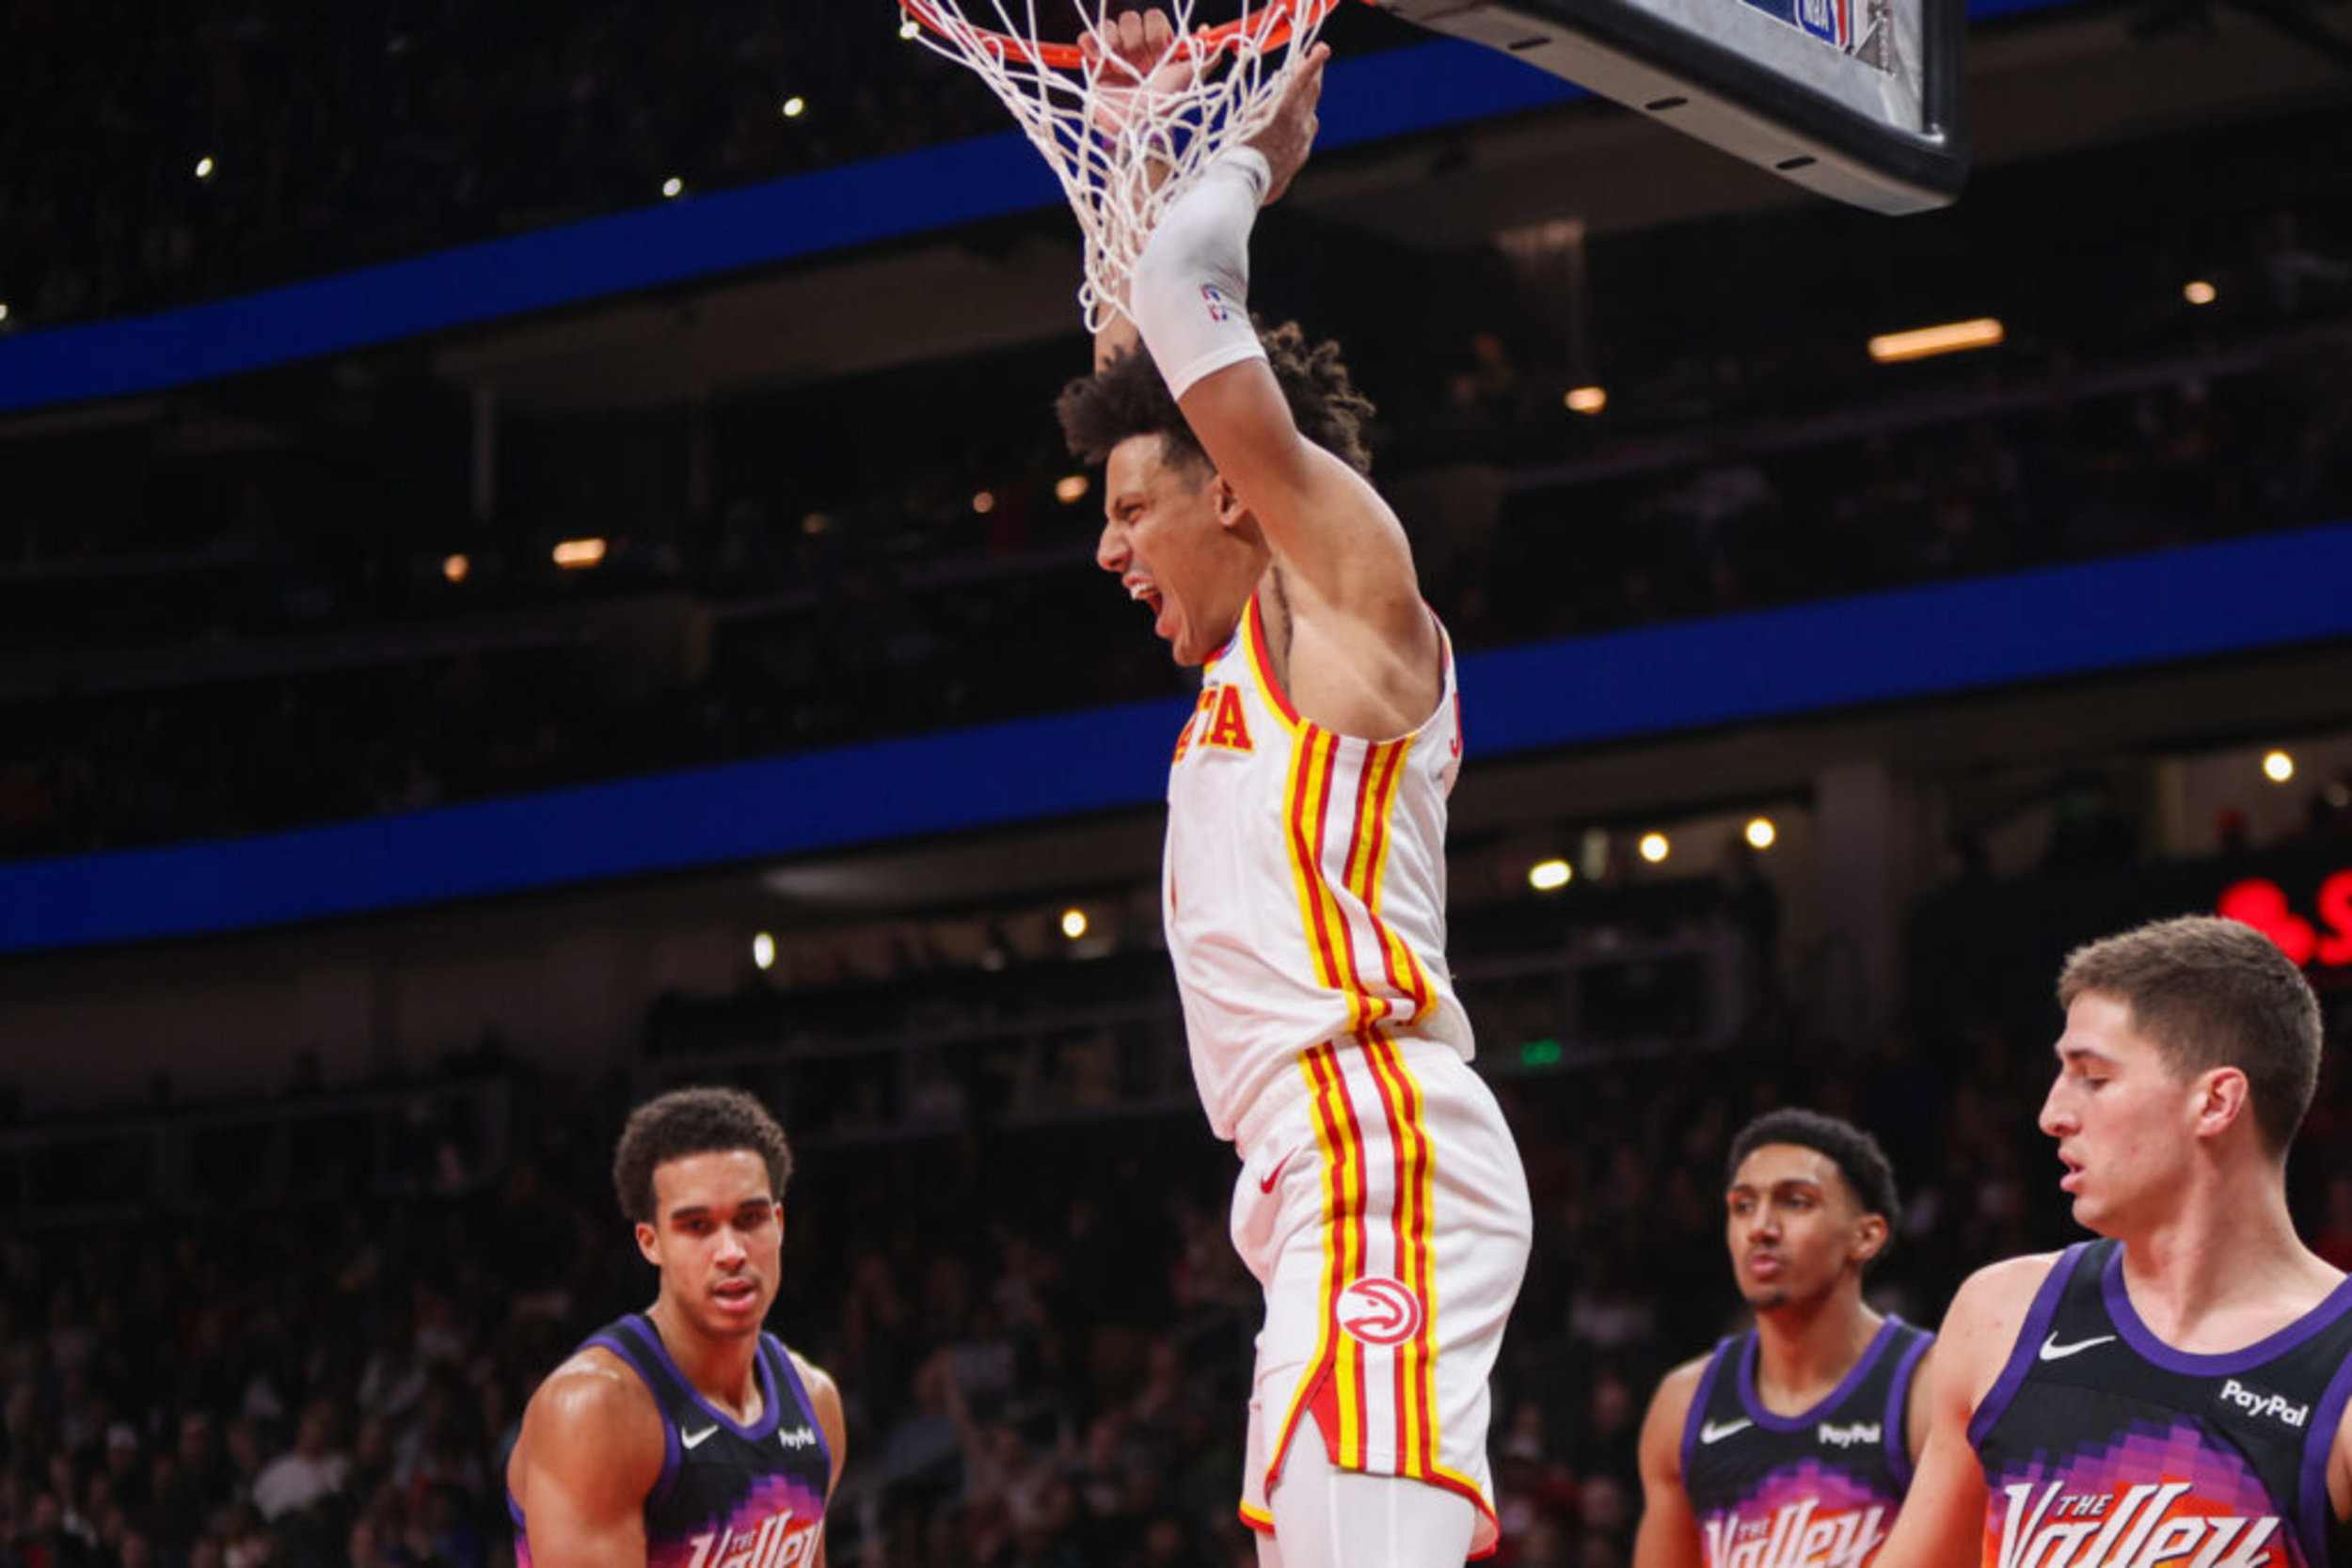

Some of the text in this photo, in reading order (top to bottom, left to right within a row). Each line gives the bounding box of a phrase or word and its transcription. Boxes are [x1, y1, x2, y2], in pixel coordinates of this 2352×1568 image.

[2220, 1379, 2309, 1427] PayPal
[1818, 1423, 1881, 1448] PayPal
[2004, 1481, 2280, 1568] Valley
[2057, 1494, 2113, 1516] THE
[1706, 1497, 1885, 1568] Valley
